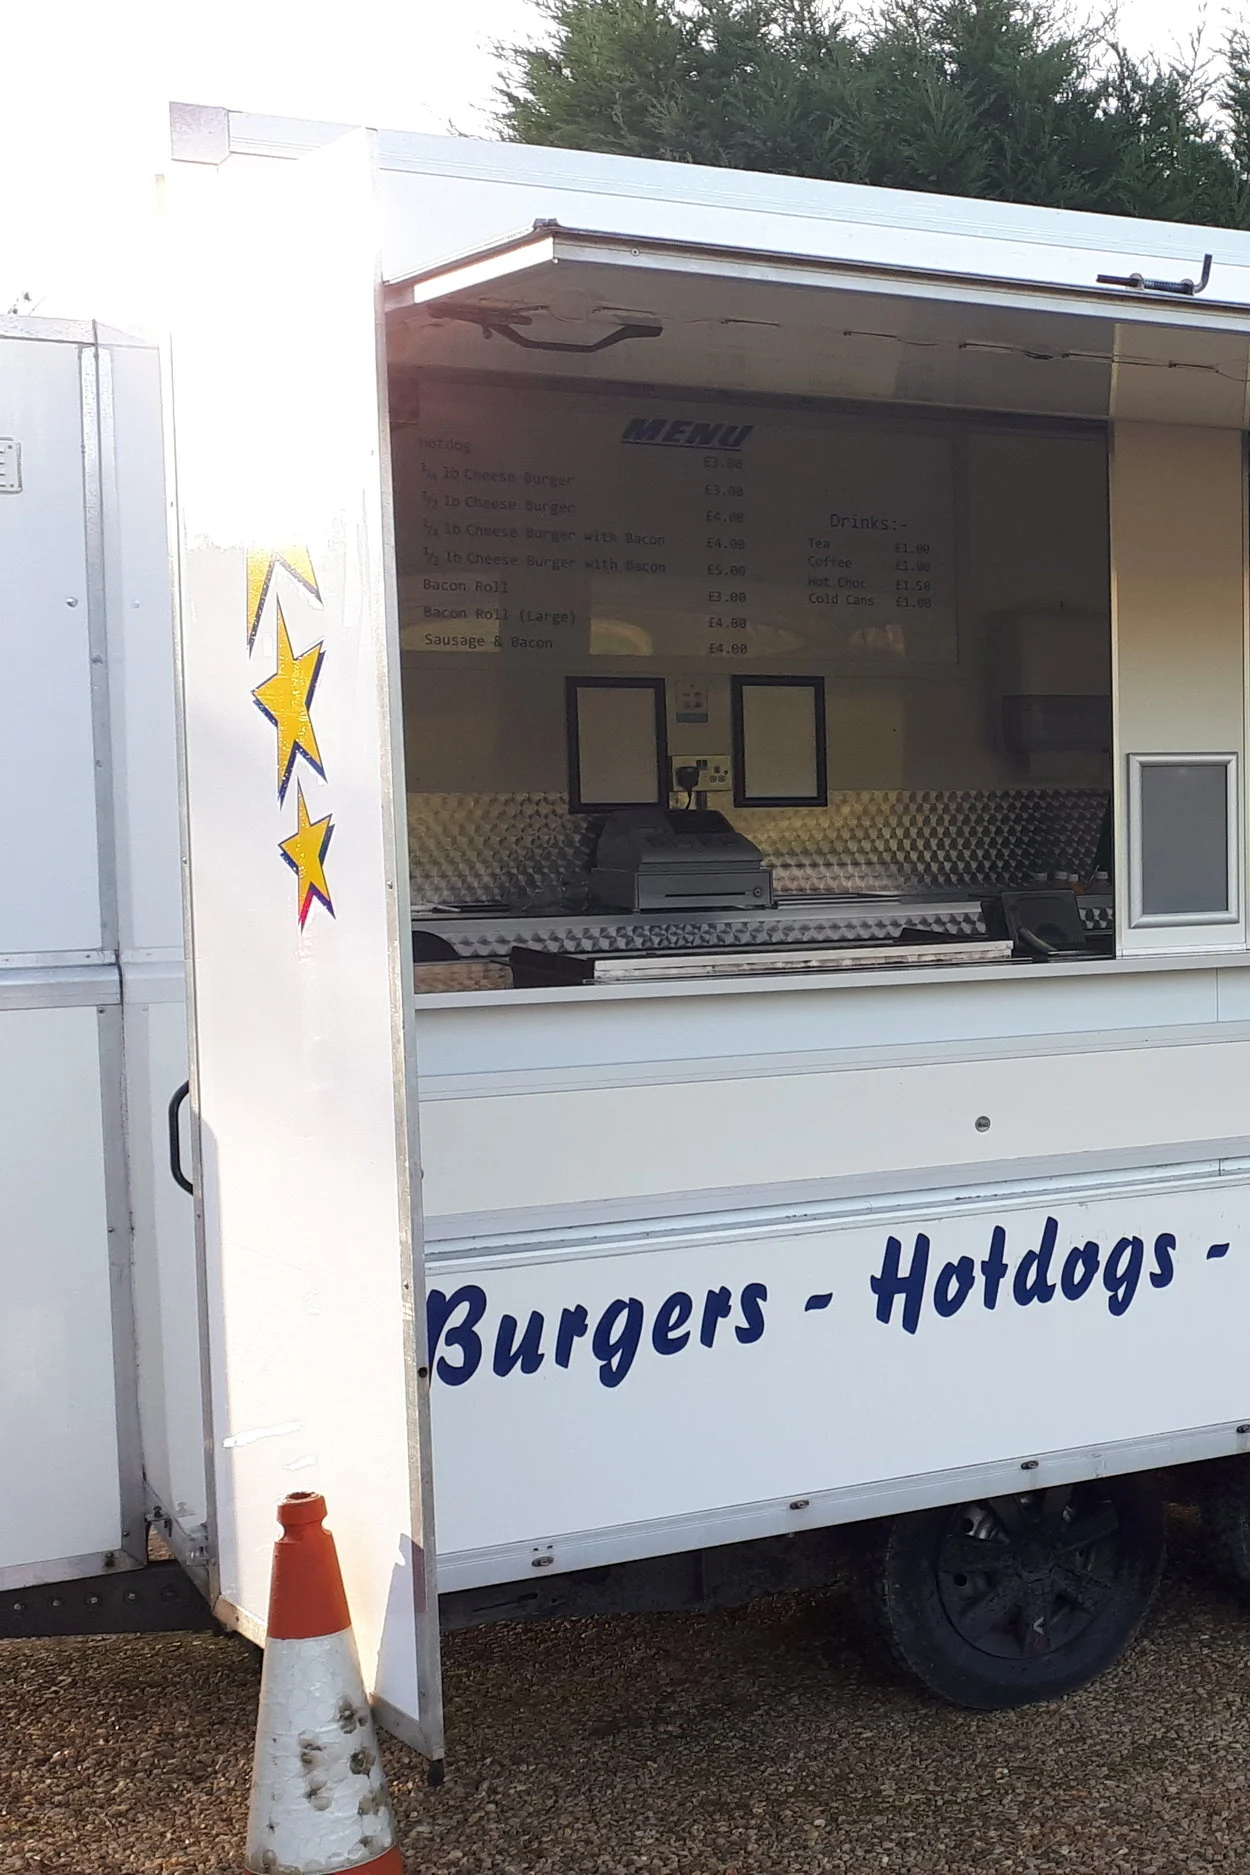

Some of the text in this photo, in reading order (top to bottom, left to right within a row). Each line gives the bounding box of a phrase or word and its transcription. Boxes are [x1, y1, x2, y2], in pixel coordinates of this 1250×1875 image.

[419, 437, 472, 453] Hotdog
[621, 418, 755, 448] MENU
[464, 468, 516, 483] Cheese
[523, 471, 575, 488] Burger
[704, 484, 744, 497] £3.00
[465, 496, 517, 511] Cheese
[525, 499, 576, 515] Burger
[705, 510, 745, 524] £4.00
[830, 513, 908, 531] Drinks:-
[466, 524, 518, 539] Cheese
[526, 527, 576, 543] Burger
[584, 530, 617, 544] with
[625, 533, 666, 546] Bacon
[706, 536, 746, 550] £4.00
[807, 537, 931, 554] Tea £1.00
[467, 552, 518, 566] Cheese
[526, 555, 577, 571] Burger
[584, 557, 617, 571] with
[626, 560, 667, 573] Bacon
[707, 564, 747, 577] £5.00
[807, 554, 931, 572] Coffee £1.00
[423, 578, 747, 603] Bacon Roll £3.00
[807, 575, 931, 591] Hot Choc £1.50
[808, 593, 932, 608] Cold Cans £1.00
[423, 605, 748, 629] Bacon Roll (Large) £4.00
[424, 633, 748, 655] Sausage & Bacon £4.00
[427, 1282, 768, 1388] Burgers
[870, 1216, 1177, 1335] Hotdogs
